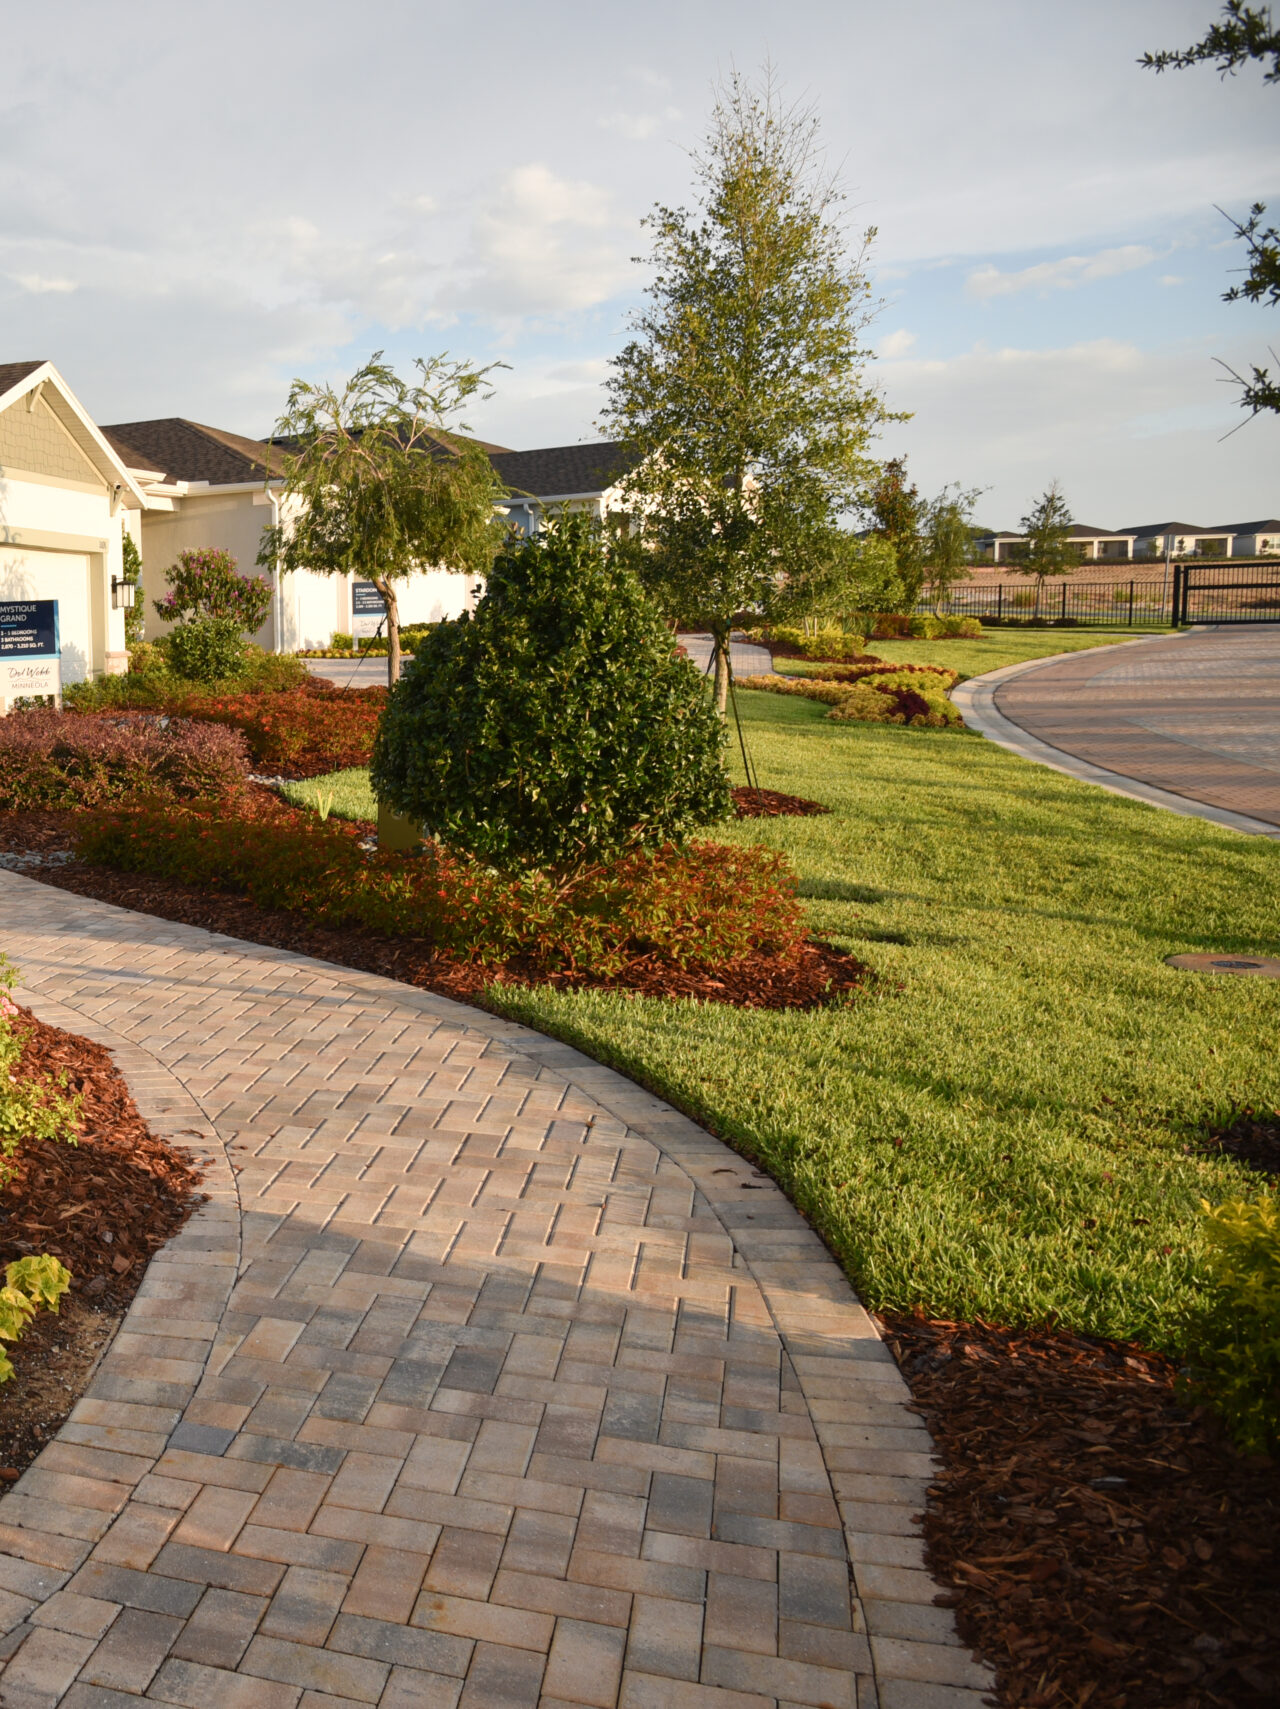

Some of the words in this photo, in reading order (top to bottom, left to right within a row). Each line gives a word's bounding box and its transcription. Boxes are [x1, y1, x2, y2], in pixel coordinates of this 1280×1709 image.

[0, 605, 37, 613] MYSTIQUE
[8, 667, 25, 678] Del
[26, 667, 50, 678] Webb
[11, 681, 48, 689] MINNEOLA
